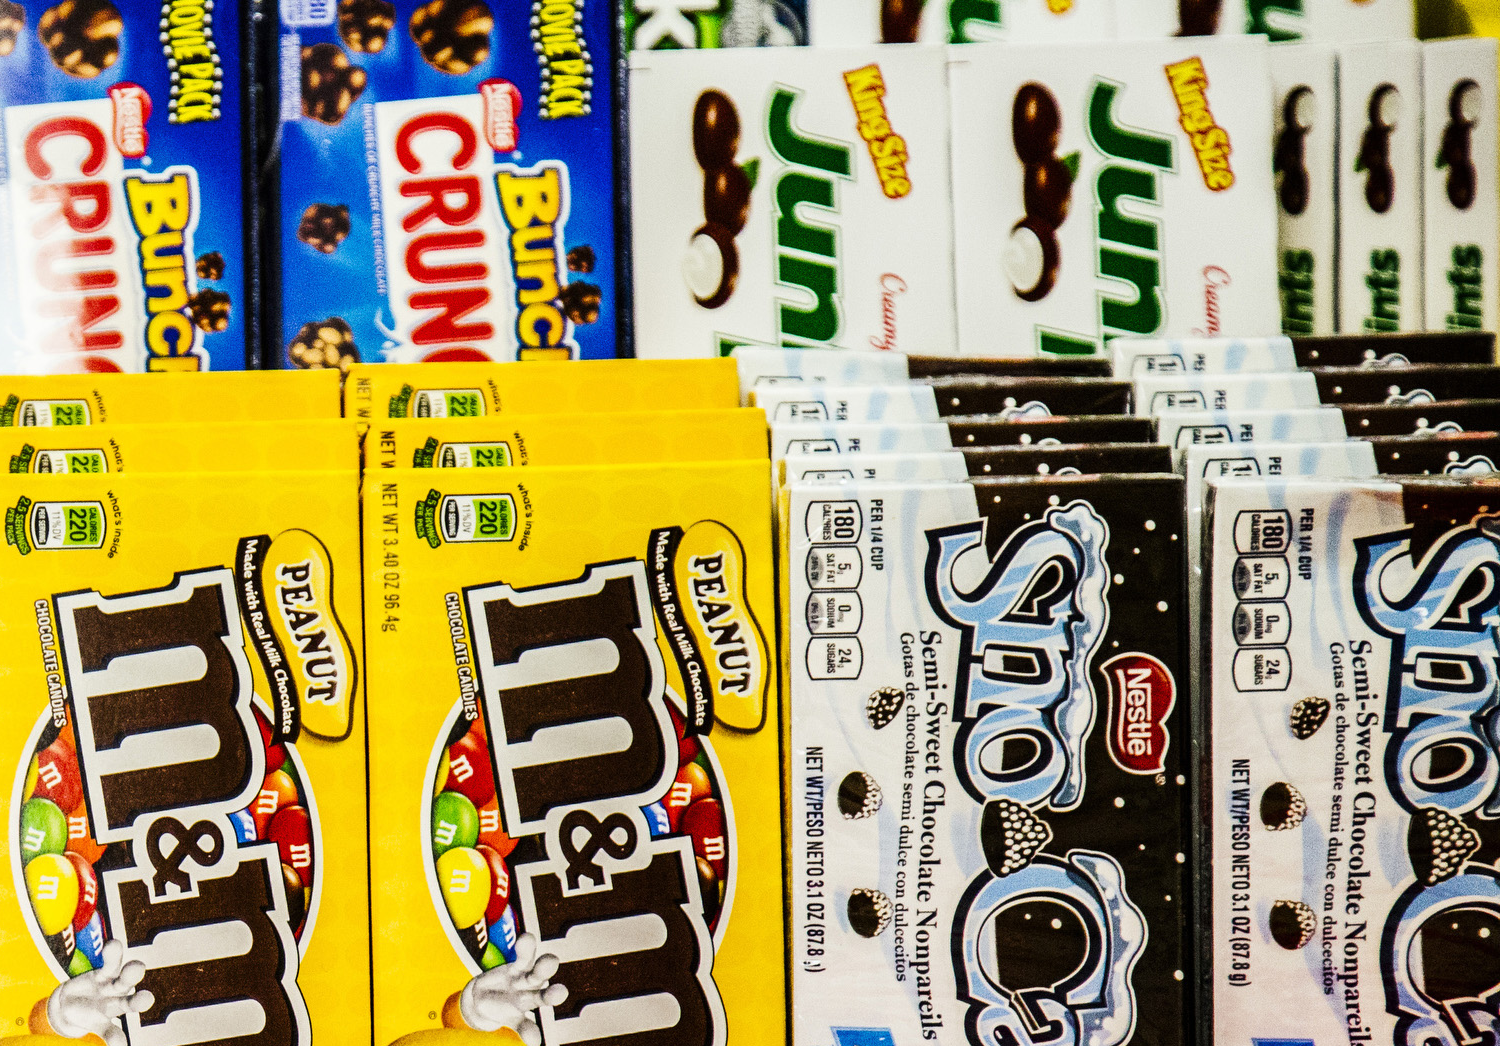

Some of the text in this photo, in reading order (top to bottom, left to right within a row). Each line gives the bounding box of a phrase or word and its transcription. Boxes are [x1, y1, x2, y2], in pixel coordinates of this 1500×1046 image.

[177, 62, 214, 123] PACK
[548, 59, 586, 120] PACK
[768, 85, 854, 348] Jun
[1088, 78, 1176, 341] Jun
[70, 508, 88, 542] 220
[90, 507, 98, 541] CALORIES
[108, 489, 124, 559] what's inside
[479, 501, 497, 535] 220
[833, 506, 855, 539] 180
[870, 498, 884, 571] PER 1/4 CUP
[1262, 515, 1284, 549] 180
[244, 539, 296, 735] Made with Real Milk Chocolate
[280, 561, 339, 702] PEANUT
[656, 531, 708, 727] Made with Real Milk Chocolate
[692, 553, 751, 694] PEANUT
[826, 643, 835, 674] SUGARS
[34, 599, 66, 726] CHOCOLATE CANDIES
[1121, 667, 1153, 757] Nestlé
[1349, 639, 1379, 786] Semi-Sweet
[806, 746, 823, 774] NET
[806, 776, 824, 837] WT/PESO
[894, 632, 920, 982] Gotas de chocolate semi dulce con dulcecitos
[909, 630, 948, 1041] Semi-Sweet Chocolate Nonpareils
[806, 840, 823, 877] NETO
[1346, 790, 1377, 916] Chocolate
[806, 878, 824, 900] 3.1
[806, 902, 824, 920] OZ
